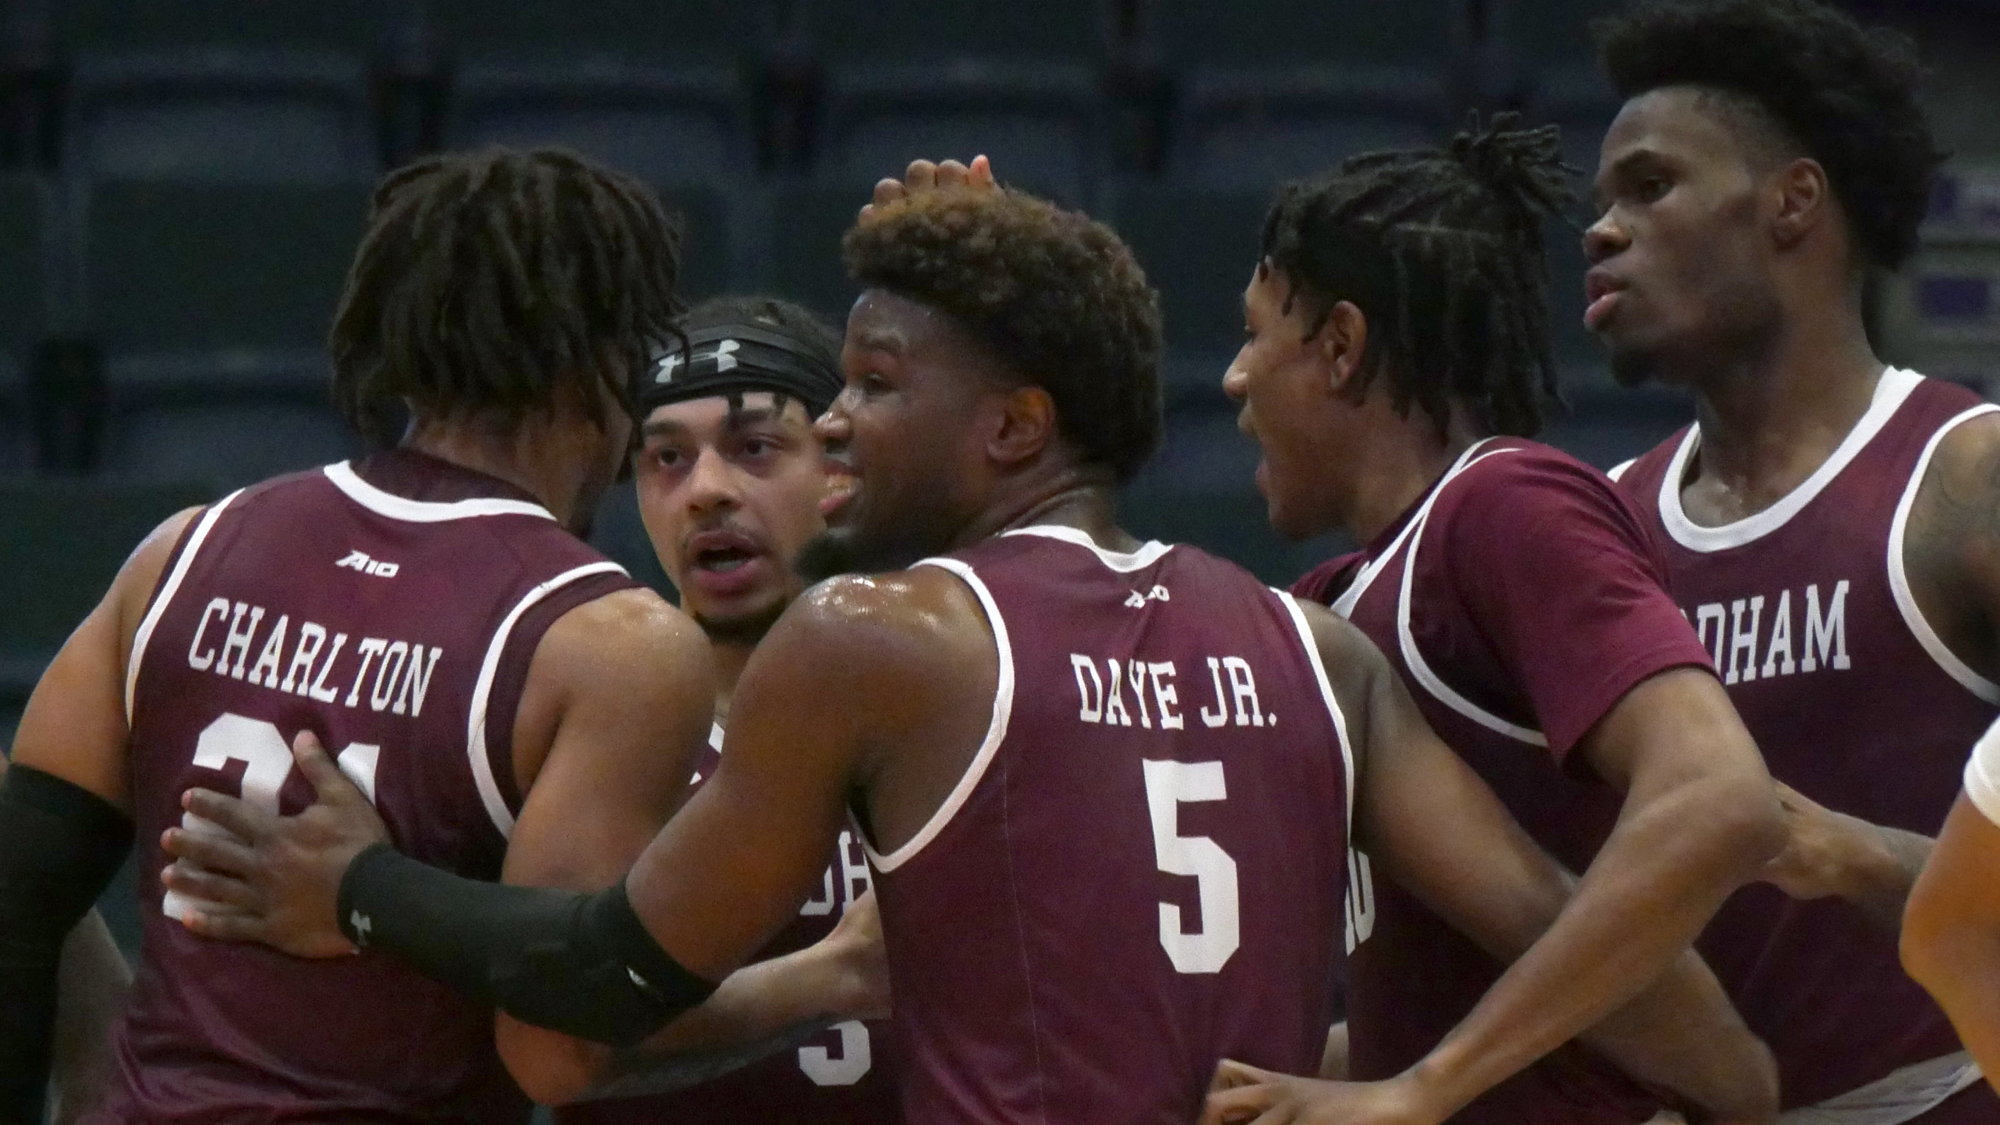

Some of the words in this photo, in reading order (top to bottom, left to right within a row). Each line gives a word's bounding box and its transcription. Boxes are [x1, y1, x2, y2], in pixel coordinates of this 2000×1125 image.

[188, 597, 443, 718] CHARLTON
[1070, 653, 1185, 730] DAYE
[1201, 656, 1278, 728] JR.
[1142, 757, 1240, 974] 5
